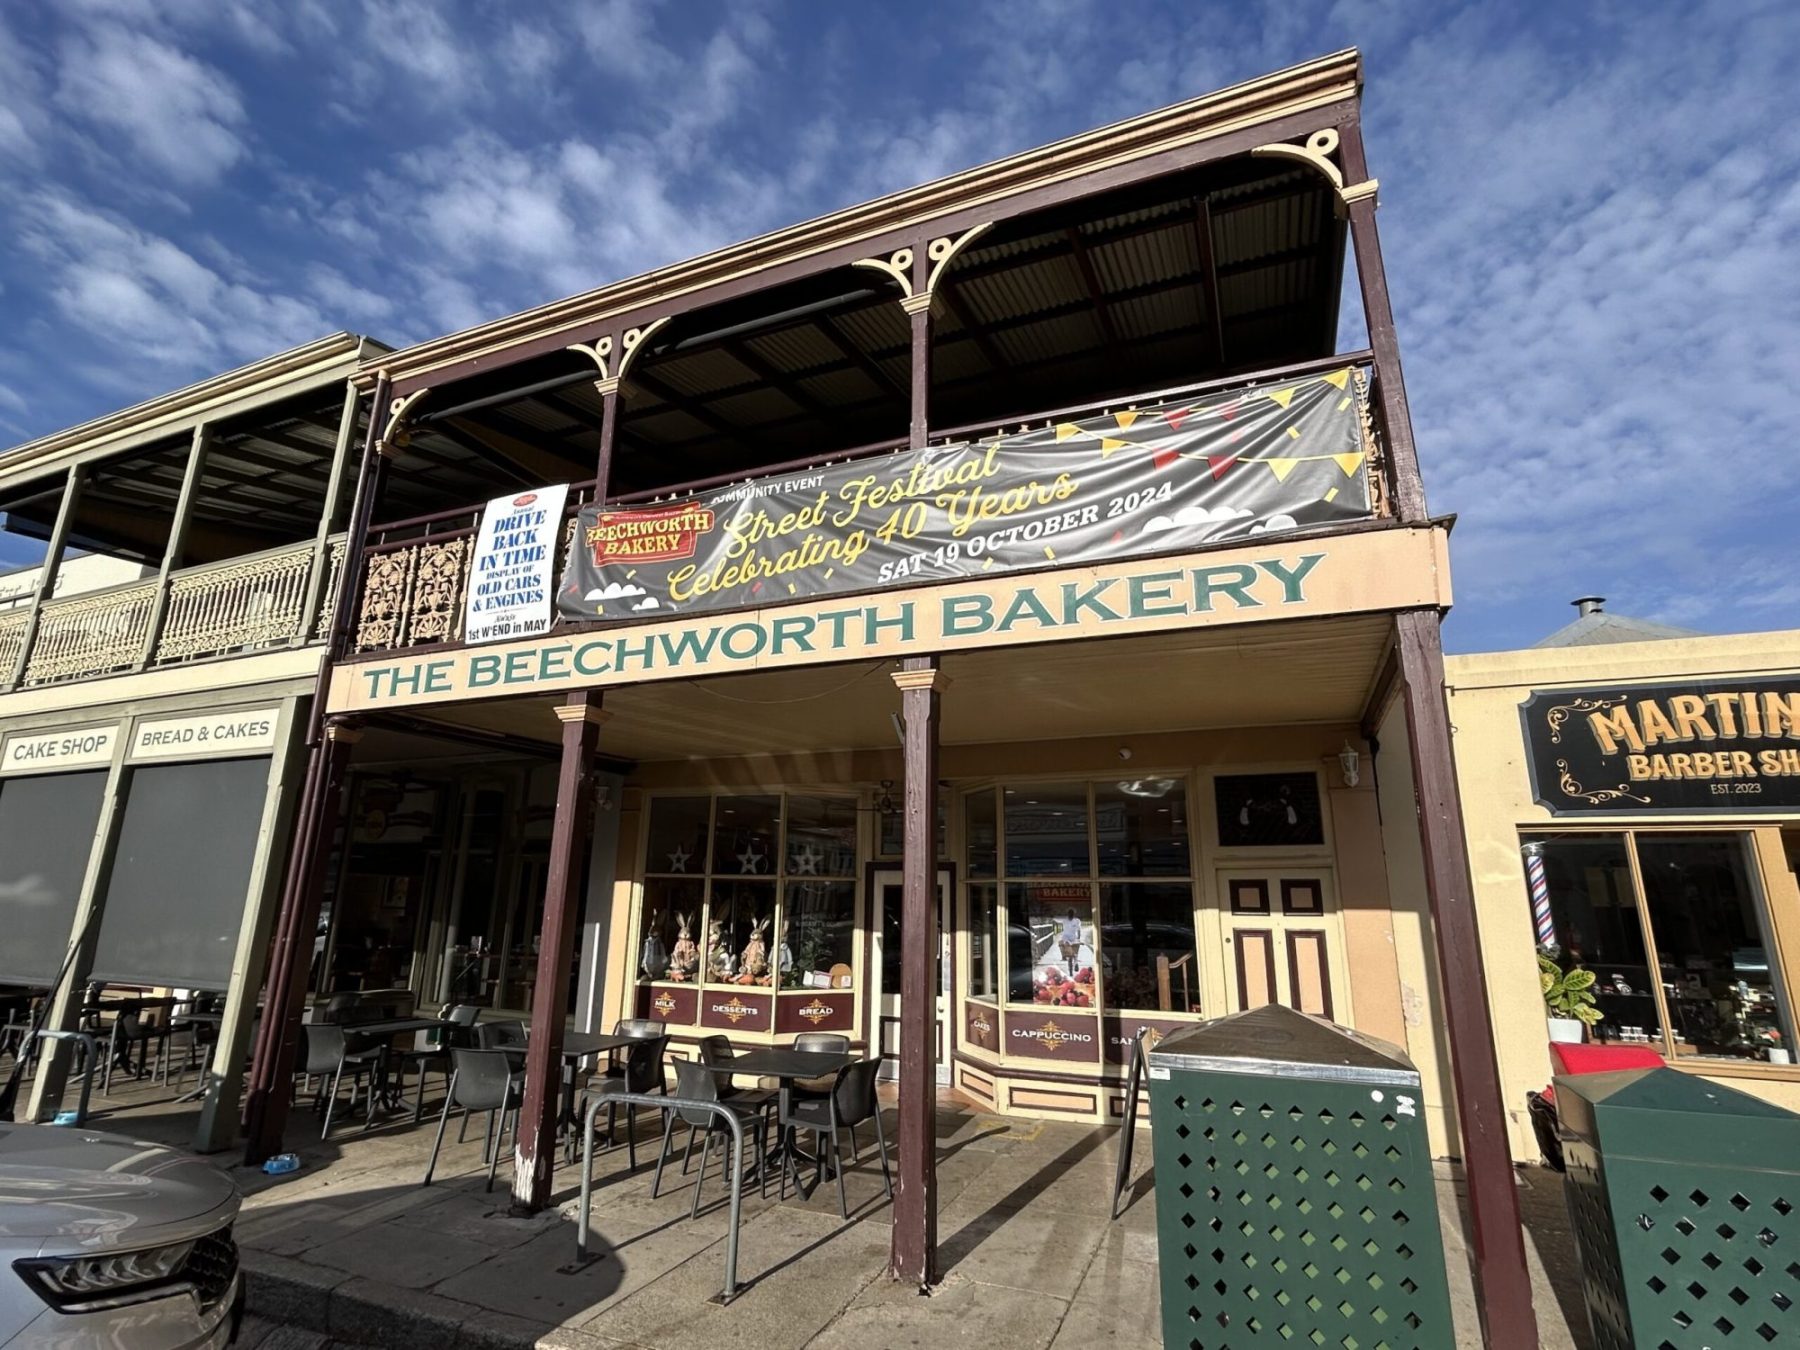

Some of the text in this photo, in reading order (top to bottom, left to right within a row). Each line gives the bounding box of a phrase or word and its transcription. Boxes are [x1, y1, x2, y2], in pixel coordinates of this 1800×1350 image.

[784, 475, 825, 493] EVENT
[723, 442, 1003, 559] Street Festival
[493, 509, 547, 534] DRIVE
[586, 513, 710, 543] BEECHWORTH
[877, 481, 1174, 584] SAT 19 OCTOBER 2024
[492, 528, 539, 551] BACK
[603, 533, 681, 555] BAKERY
[667, 472, 1080, 601] Celebrating 40 Years
[479, 545, 547, 572] IN TIME
[486, 564, 535, 580] DISPLAY OF
[477, 574, 542, 596] OLD CARS
[472, 589, 544, 613] & ENGINES
[363, 553, 1328, 700] THE BEECHWORTH BAKERY
[468, 618, 547, 641] 1st W'END in MAY
[141, 720, 271, 747] BREAD & CAKES
[13, 734, 109, 762] CAKE SHOP
[1626, 750, 1758, 782] BARBER
[1710, 782, 1762, 795] EST. 2023
[655, 1000, 675, 1009] MILK
[712, 1004, 758, 1016] DESSERTS
[799, 1007, 834, 1016] BREAD
[1012, 1029, 1092, 1043] CAPPUCCINO
